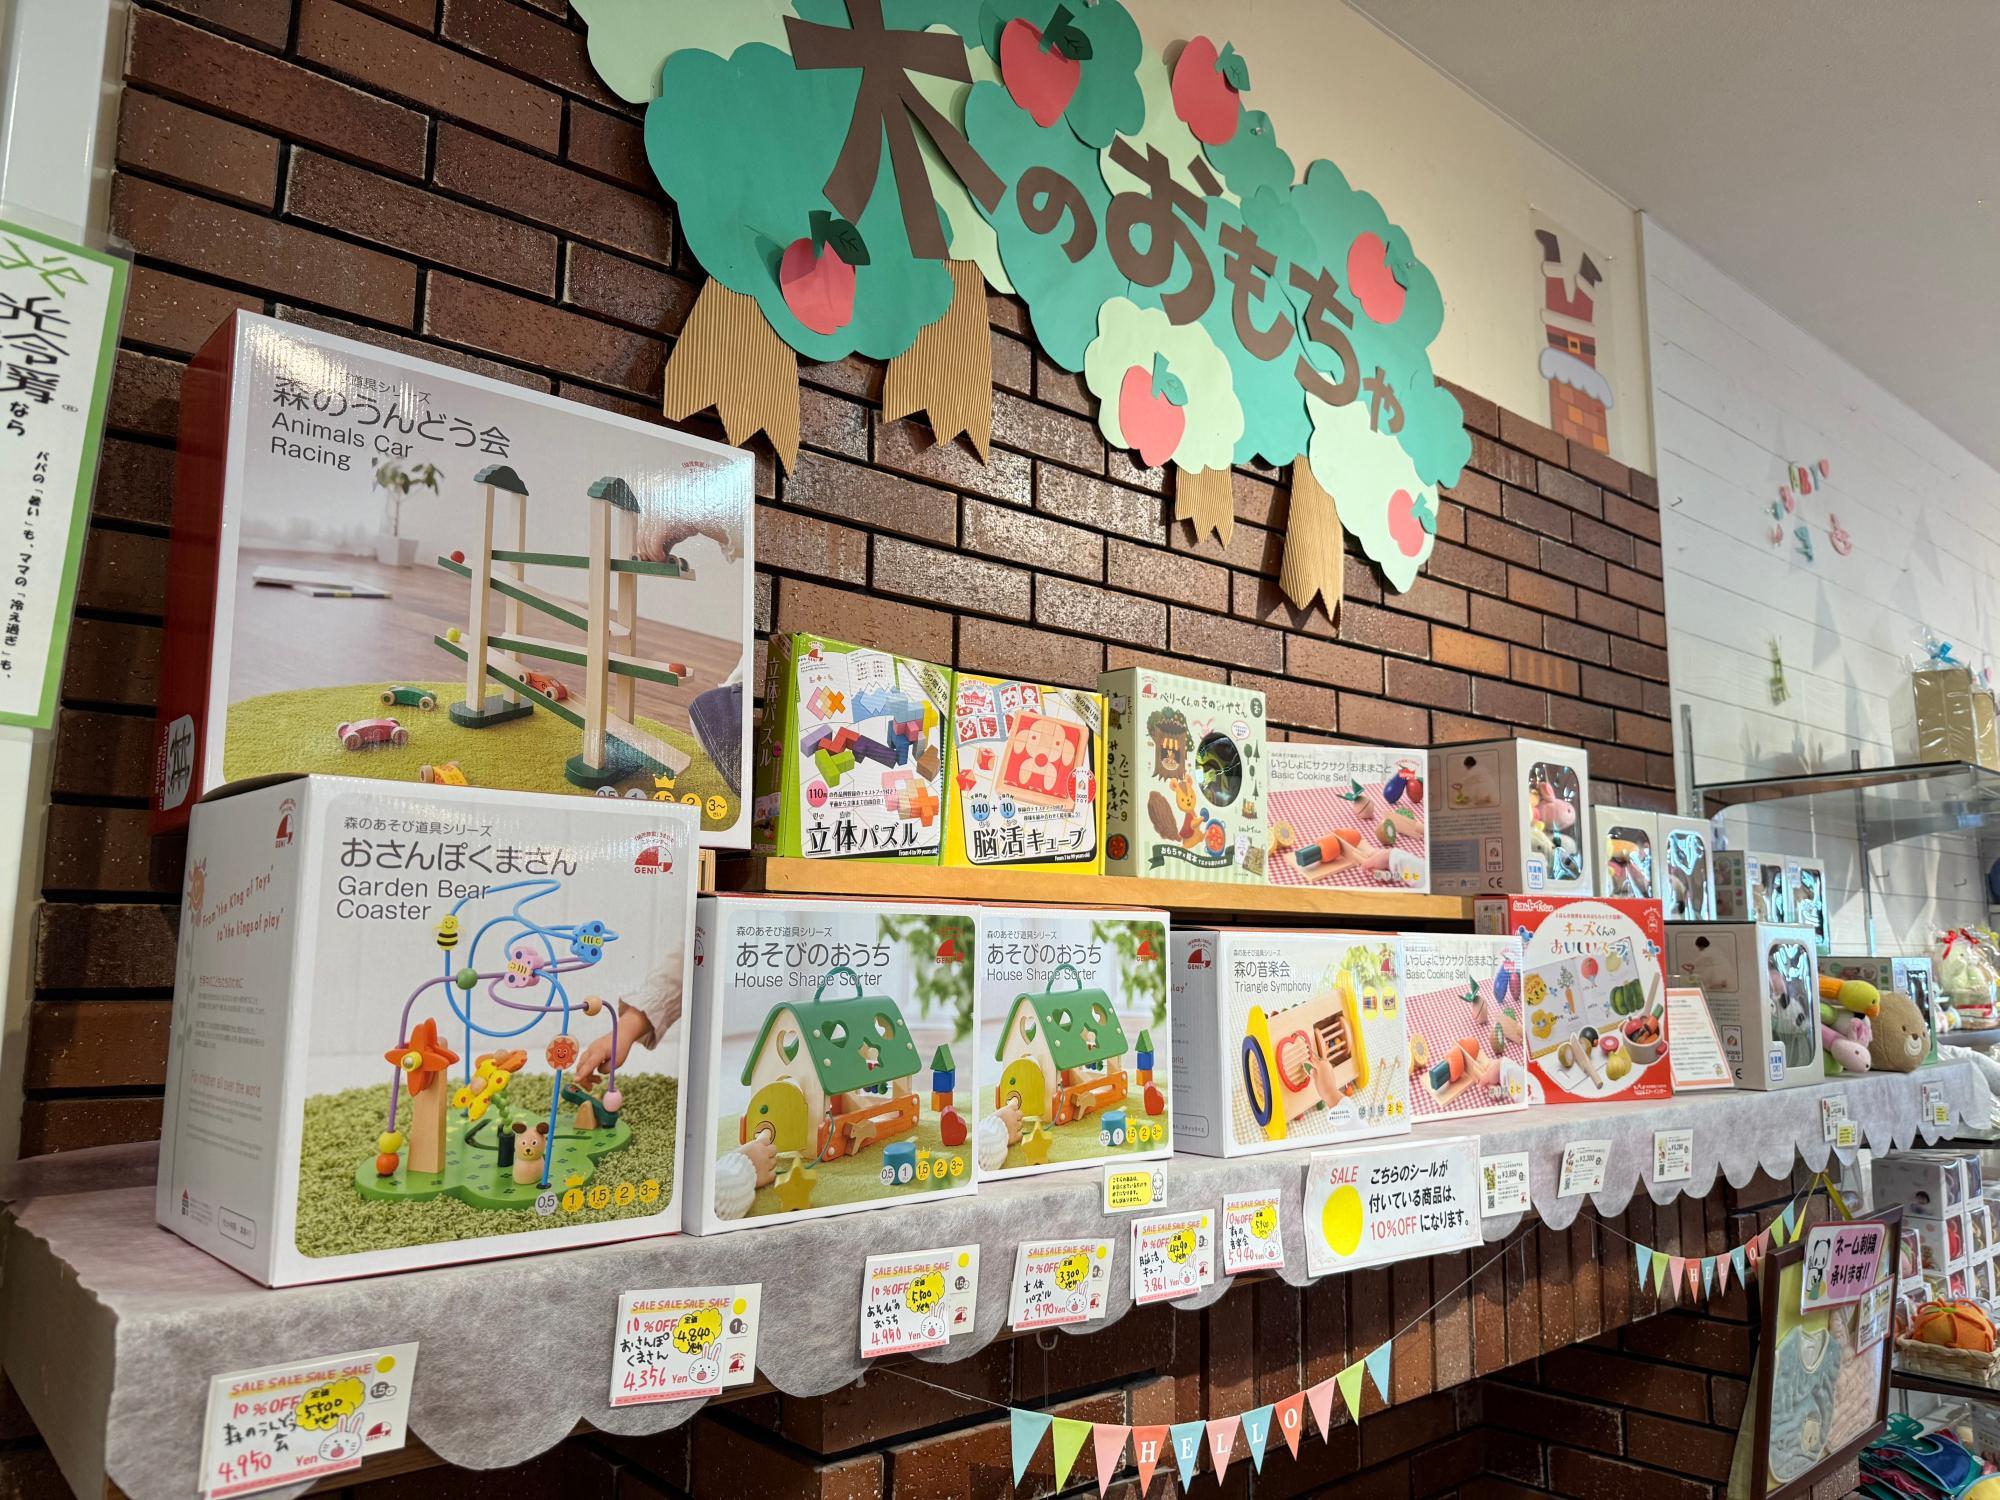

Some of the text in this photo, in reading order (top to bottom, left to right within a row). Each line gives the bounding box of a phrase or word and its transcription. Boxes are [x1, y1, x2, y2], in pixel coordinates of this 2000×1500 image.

[783, 0, 1404, 433] 木のおもちゃ
[273, 376, 510, 458] 森のうんどう会
[271, 411, 414, 458] Animals Car
[271, 436, 351, 471] Racing
[760, 657, 780, 767] 立体パズル
[1271, 771, 1347, 782] Basic Cooking Set
[344, 817, 493, 837] 森のあそび道具シリーズ
[807, 820, 918, 854] 立体パズル
[973, 825, 1087, 858] 脳活キューブ
[340, 837, 578, 877] おさんぽくまさん
[634, 866, 658, 875] GENI
[338, 876, 492, 900] Garden Bear
[336, 899, 432, 921] Coaster
[736, 926, 833, 937] 森のあそび道具シリーズ
[986, 930, 1057, 940] 森のあそび道具シリーズ
[1563, 921, 1616, 937] チーズくんの
[736, 942, 891, 968] あそびのおうち
[987, 943, 1101, 965] あそびのおうち
[1551, 938, 1629, 956] おいしいスープ
[987, 967, 1097, 982] House Shape Sorter
[1234, 960, 1290, 978] 森の音楽会
[1405, 968, 1467, 981] Basic Cooking Set
[735, 971, 883, 989] House Shape Sorter
[1235, 980, 1312, 994] Triangle Symphony
[1141, 1128, 1148, 1137] 2
[881, 1168, 894, 1180] 0.5
[917, 1164, 929, 1175] 1.5
[936, 1162, 944, 1172] 2
[1330, 1164, 1359, 1185] SALE
[1370, 1159, 1449, 1185] こちらのシールが
[537, 1195, 555, 1208] 0.5
[591, 1188, 607, 1203] 1.5
[619, 1186, 629, 1199] 2
[1368, 1185, 1456, 1214] 付いている商品は、
[1420, 1208, 1470, 1233] になります。
[1028, 1248, 1045, 1257] SALE
[1045, 1247, 1062, 1255] SALE
[873, 1267, 892, 1277] SALE
[893, 1265, 913, 1275] SALE
[913, 1263, 930, 1273] SALE
[632, 1297, 730, 1312] SALE SALE SALE SALE
[619, 1332, 671, 1353] おさんぽ
[908, 1331, 922, 1340] Yen
[626, 1350, 669, 1368] くまさん
[231, 1362, 373, 1397] SALE SALE SALE SALE
[623, 1365, 688, 1392] 4.356 Yen
[1141, 1407, 1298, 1463] HELLO
[218, 1450, 318, 1484] 4.950 Yen
